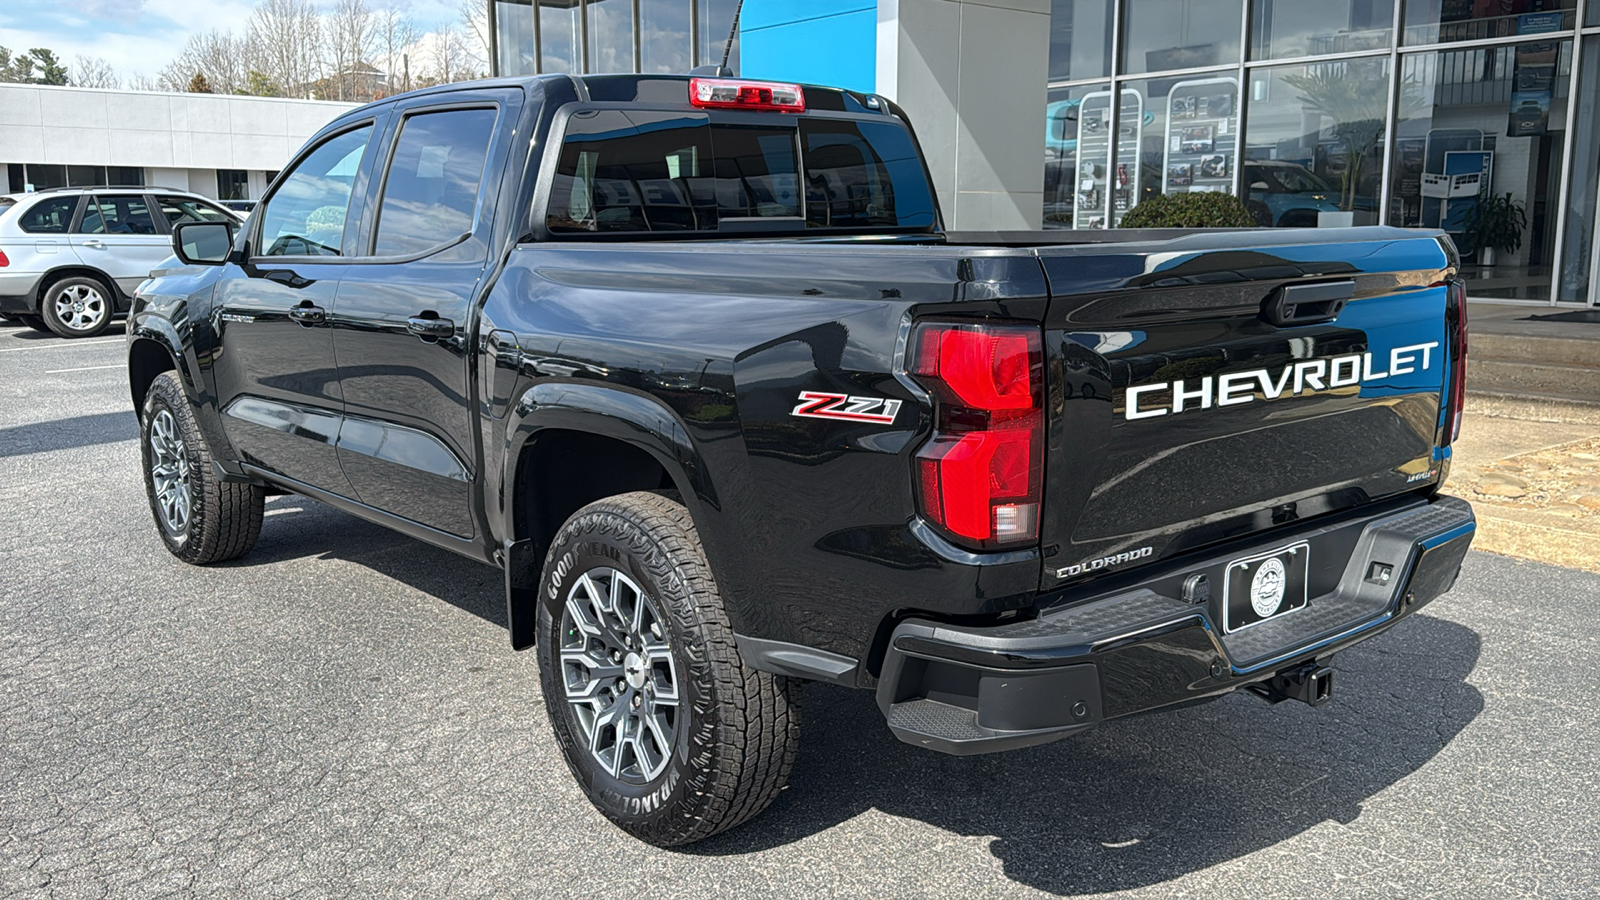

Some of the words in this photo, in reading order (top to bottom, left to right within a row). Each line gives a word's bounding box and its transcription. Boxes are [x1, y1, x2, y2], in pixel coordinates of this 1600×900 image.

[1125, 341, 1438, 421] CHEVROLET
[792, 390, 903, 425] Z71
[1056, 546, 1153, 579] COLORADO
